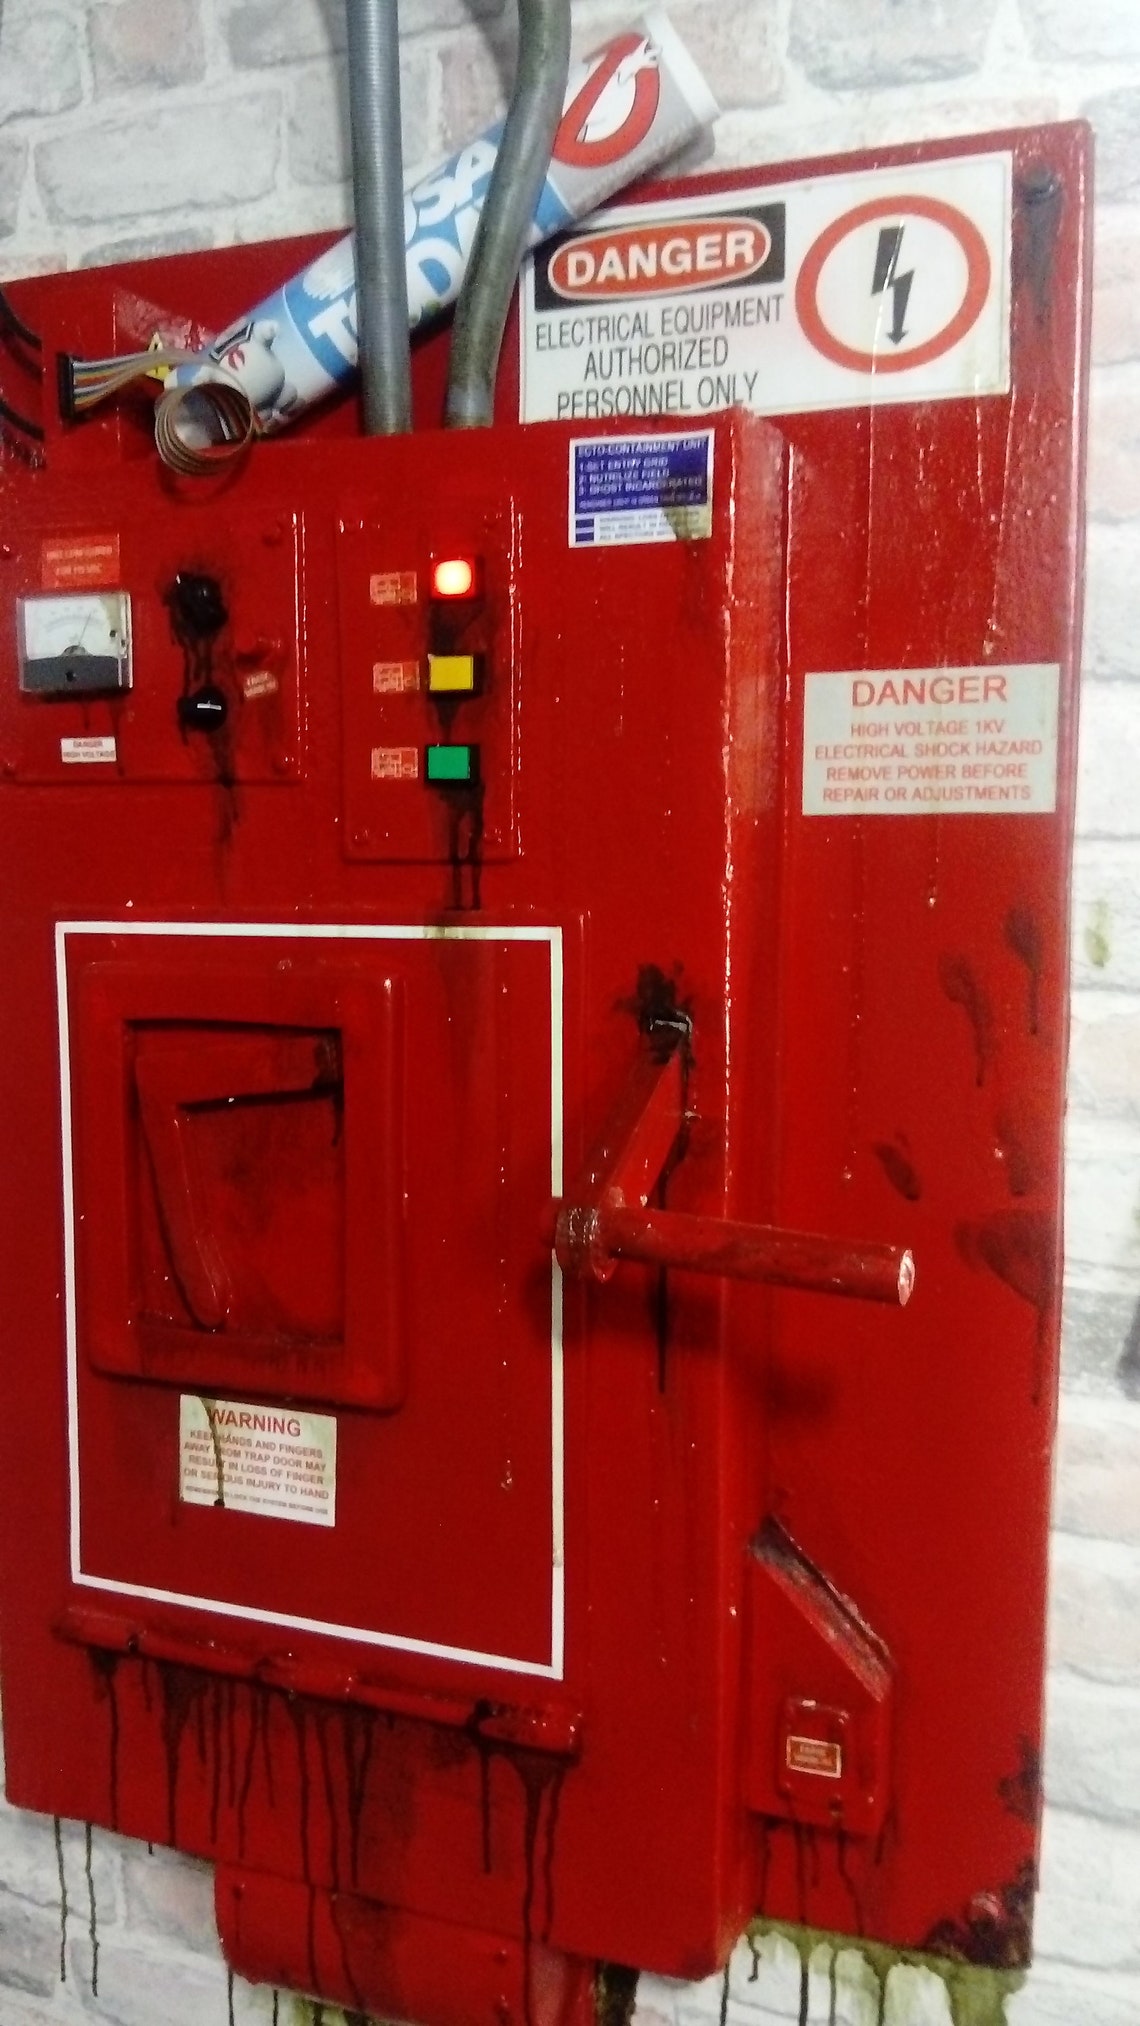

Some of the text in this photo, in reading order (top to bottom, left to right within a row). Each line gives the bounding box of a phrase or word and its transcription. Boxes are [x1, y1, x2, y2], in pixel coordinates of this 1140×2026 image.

[567, 230, 756, 287] DANGER
[536, 294, 784, 350] ELECTRICAL EQUIPMENT
[584, 336, 729, 381] AUTHORIZED
[557, 370, 759, 419] PERSONNEL ONLY
[852, 675, 1007, 707] DANGER
[851, 719, 1006, 737] HIGH VOLTAGE 1KV
[815, 740, 1042, 760] ELECTRICAL SHOCK HAZARD
[827, 763, 1027, 781] REMOVE POWER BEFORE
[823, 785, 1031, 802] REPAIR OR ADJUSTMENTS
[209, 1408, 301, 1438] WARNING
[184, 1441, 210, 1453] AWAY
[245, 1451, 270, 1463] TRAP
[273, 1456, 302, 1468] DOOR
[305, 1460, 326, 1472] MAY
[256, 1440, 276, 1452] AND
[279, 1443, 323, 1459] FINGERS
[184, 1467, 329, 1500] OR SEOUS INJURY TO HAND
[189, 1454, 324, 1485] RESU IN LOSS OF FINGER
